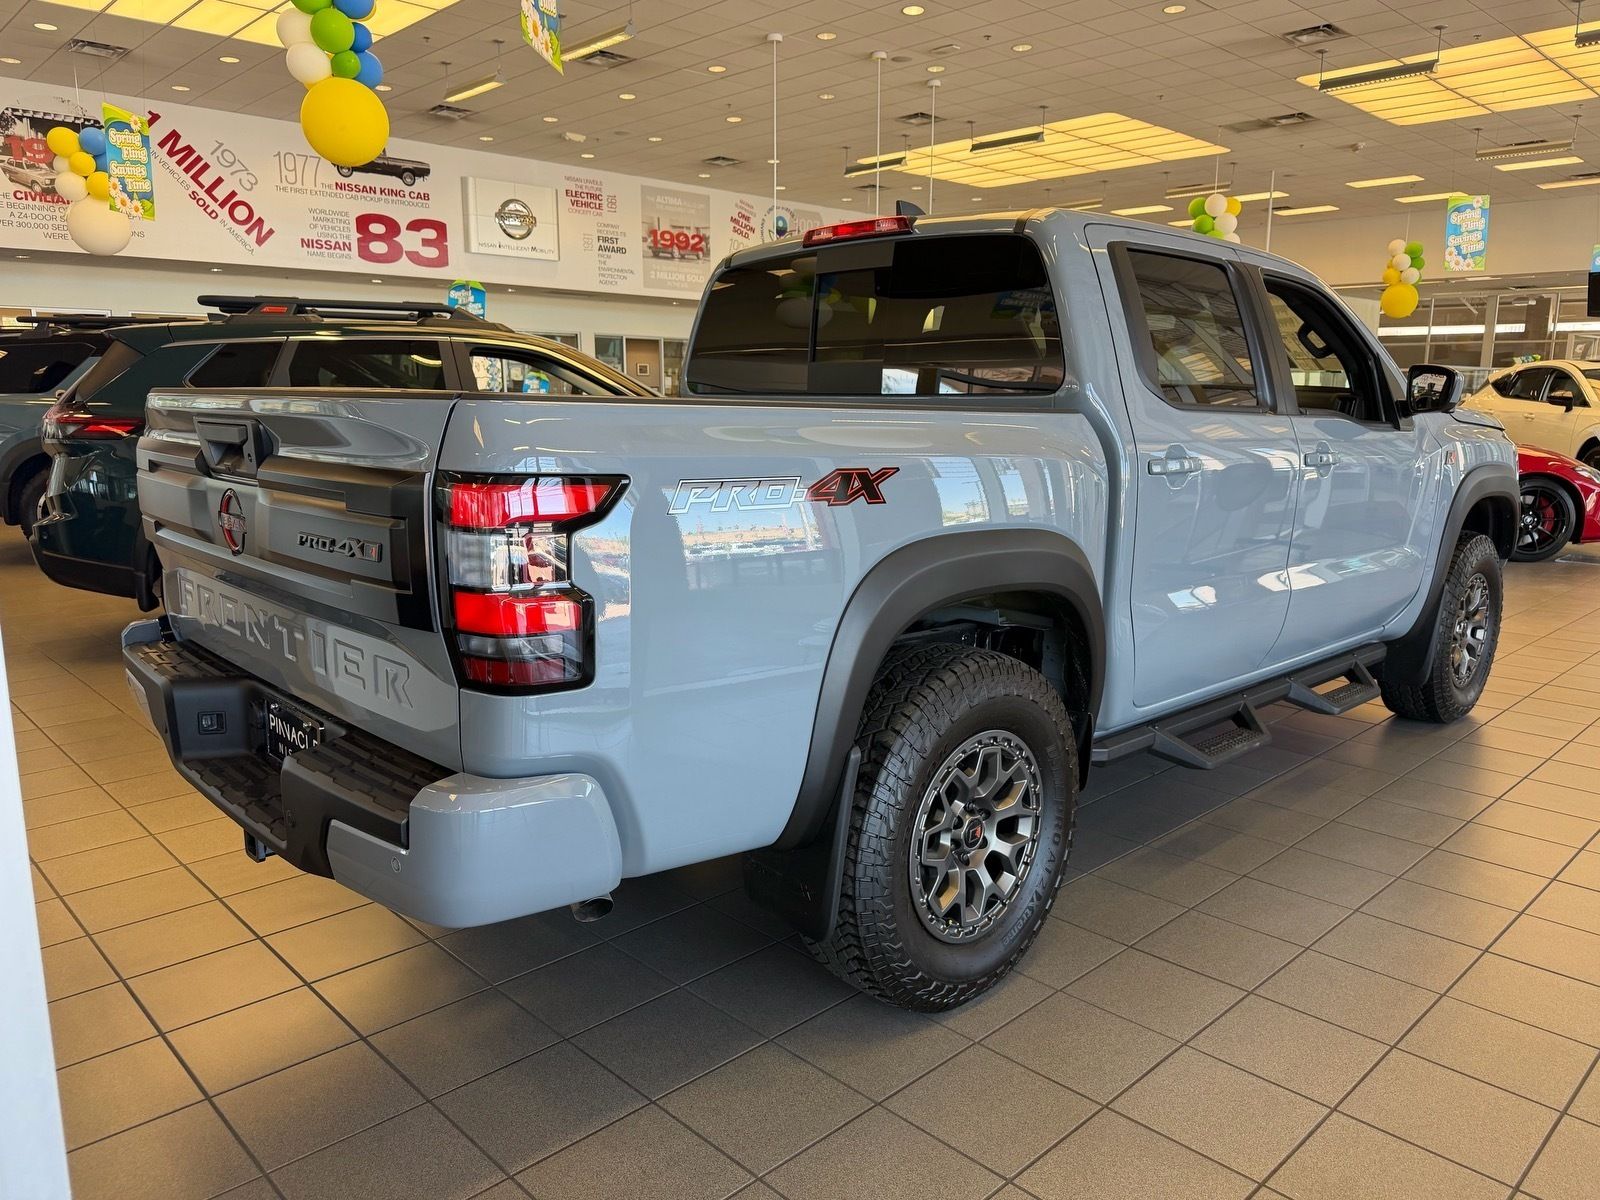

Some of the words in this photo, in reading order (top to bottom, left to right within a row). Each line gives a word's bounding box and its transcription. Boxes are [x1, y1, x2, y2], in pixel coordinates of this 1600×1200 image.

[110, 128, 142, 148] Spring
[122, 147, 148, 163] Fling
[110, 161, 147, 177] Savings
[210, 140, 259, 192] 1973
[273, 151, 321, 188] 1977
[126, 178, 151, 191] Time
[147, 110, 162, 128] 1
[157, 129, 276, 247] MILLION
[13, 190, 71, 205] CIVILIA
[275, 184, 289, 193] THE
[289, 186, 309, 195] FIRST
[309, 189, 344, 200] EXTENDED
[345, 193, 359, 201] CAB
[321, 182, 334, 190] THE
[335, 181, 377, 195] NISSAN
[379, 186, 406, 198] KING
[408, 190, 430, 201] CAB
[565, 189, 604, 201] ELECTRIC
[6, 201, 56, 212] BEGINNING
[158, 159, 191, 191] VEHICLES
[188, 190, 219, 220] SOLD
[227, 226, 255, 256] AMERICA
[308, 207, 350, 218] WORLDWIDE
[570, 199, 604, 211] VEHICLE
[312, 215, 351, 226] MARKETING
[737, 211, 752, 223] ONE
[15, 220, 50, 230] 300,000
[309, 223, 319, 231] OF
[319, 224, 351, 233] VEHICLES
[730, 216, 756, 235] MILLION
[43, 231, 70, 241] WERE
[316, 231, 338, 240] USING
[338, 233, 352, 241] THE
[355, 213, 449, 268] 83
[597, 235, 620, 245] FIRST
[648, 228, 705, 253] 1992
[300, 237, 352, 252] NISSAN
[597, 244, 627, 255] AWARD
[667, 467, 900, 516] PRO-4X
[179, 571, 414, 709] FRONTIER
[269, 713, 318, 750] PINNACL
